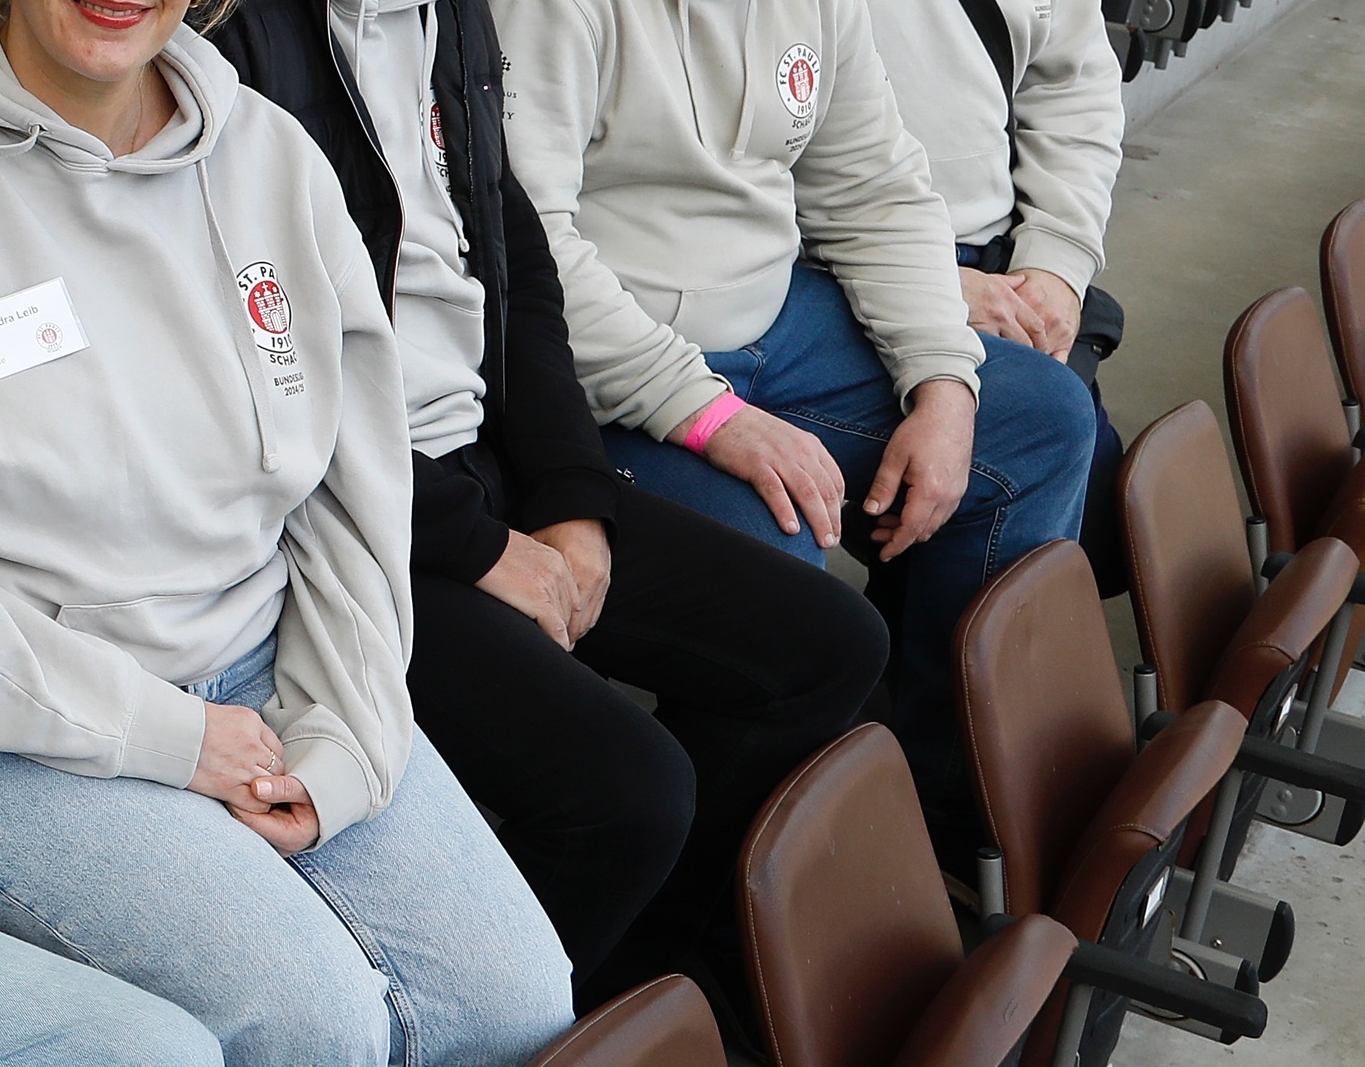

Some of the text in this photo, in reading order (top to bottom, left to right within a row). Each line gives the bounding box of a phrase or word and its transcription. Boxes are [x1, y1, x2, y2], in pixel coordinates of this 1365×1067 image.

[780, 47, 820, 85] FC ST. PAULI
[16, 305, 40, 319] Leib
